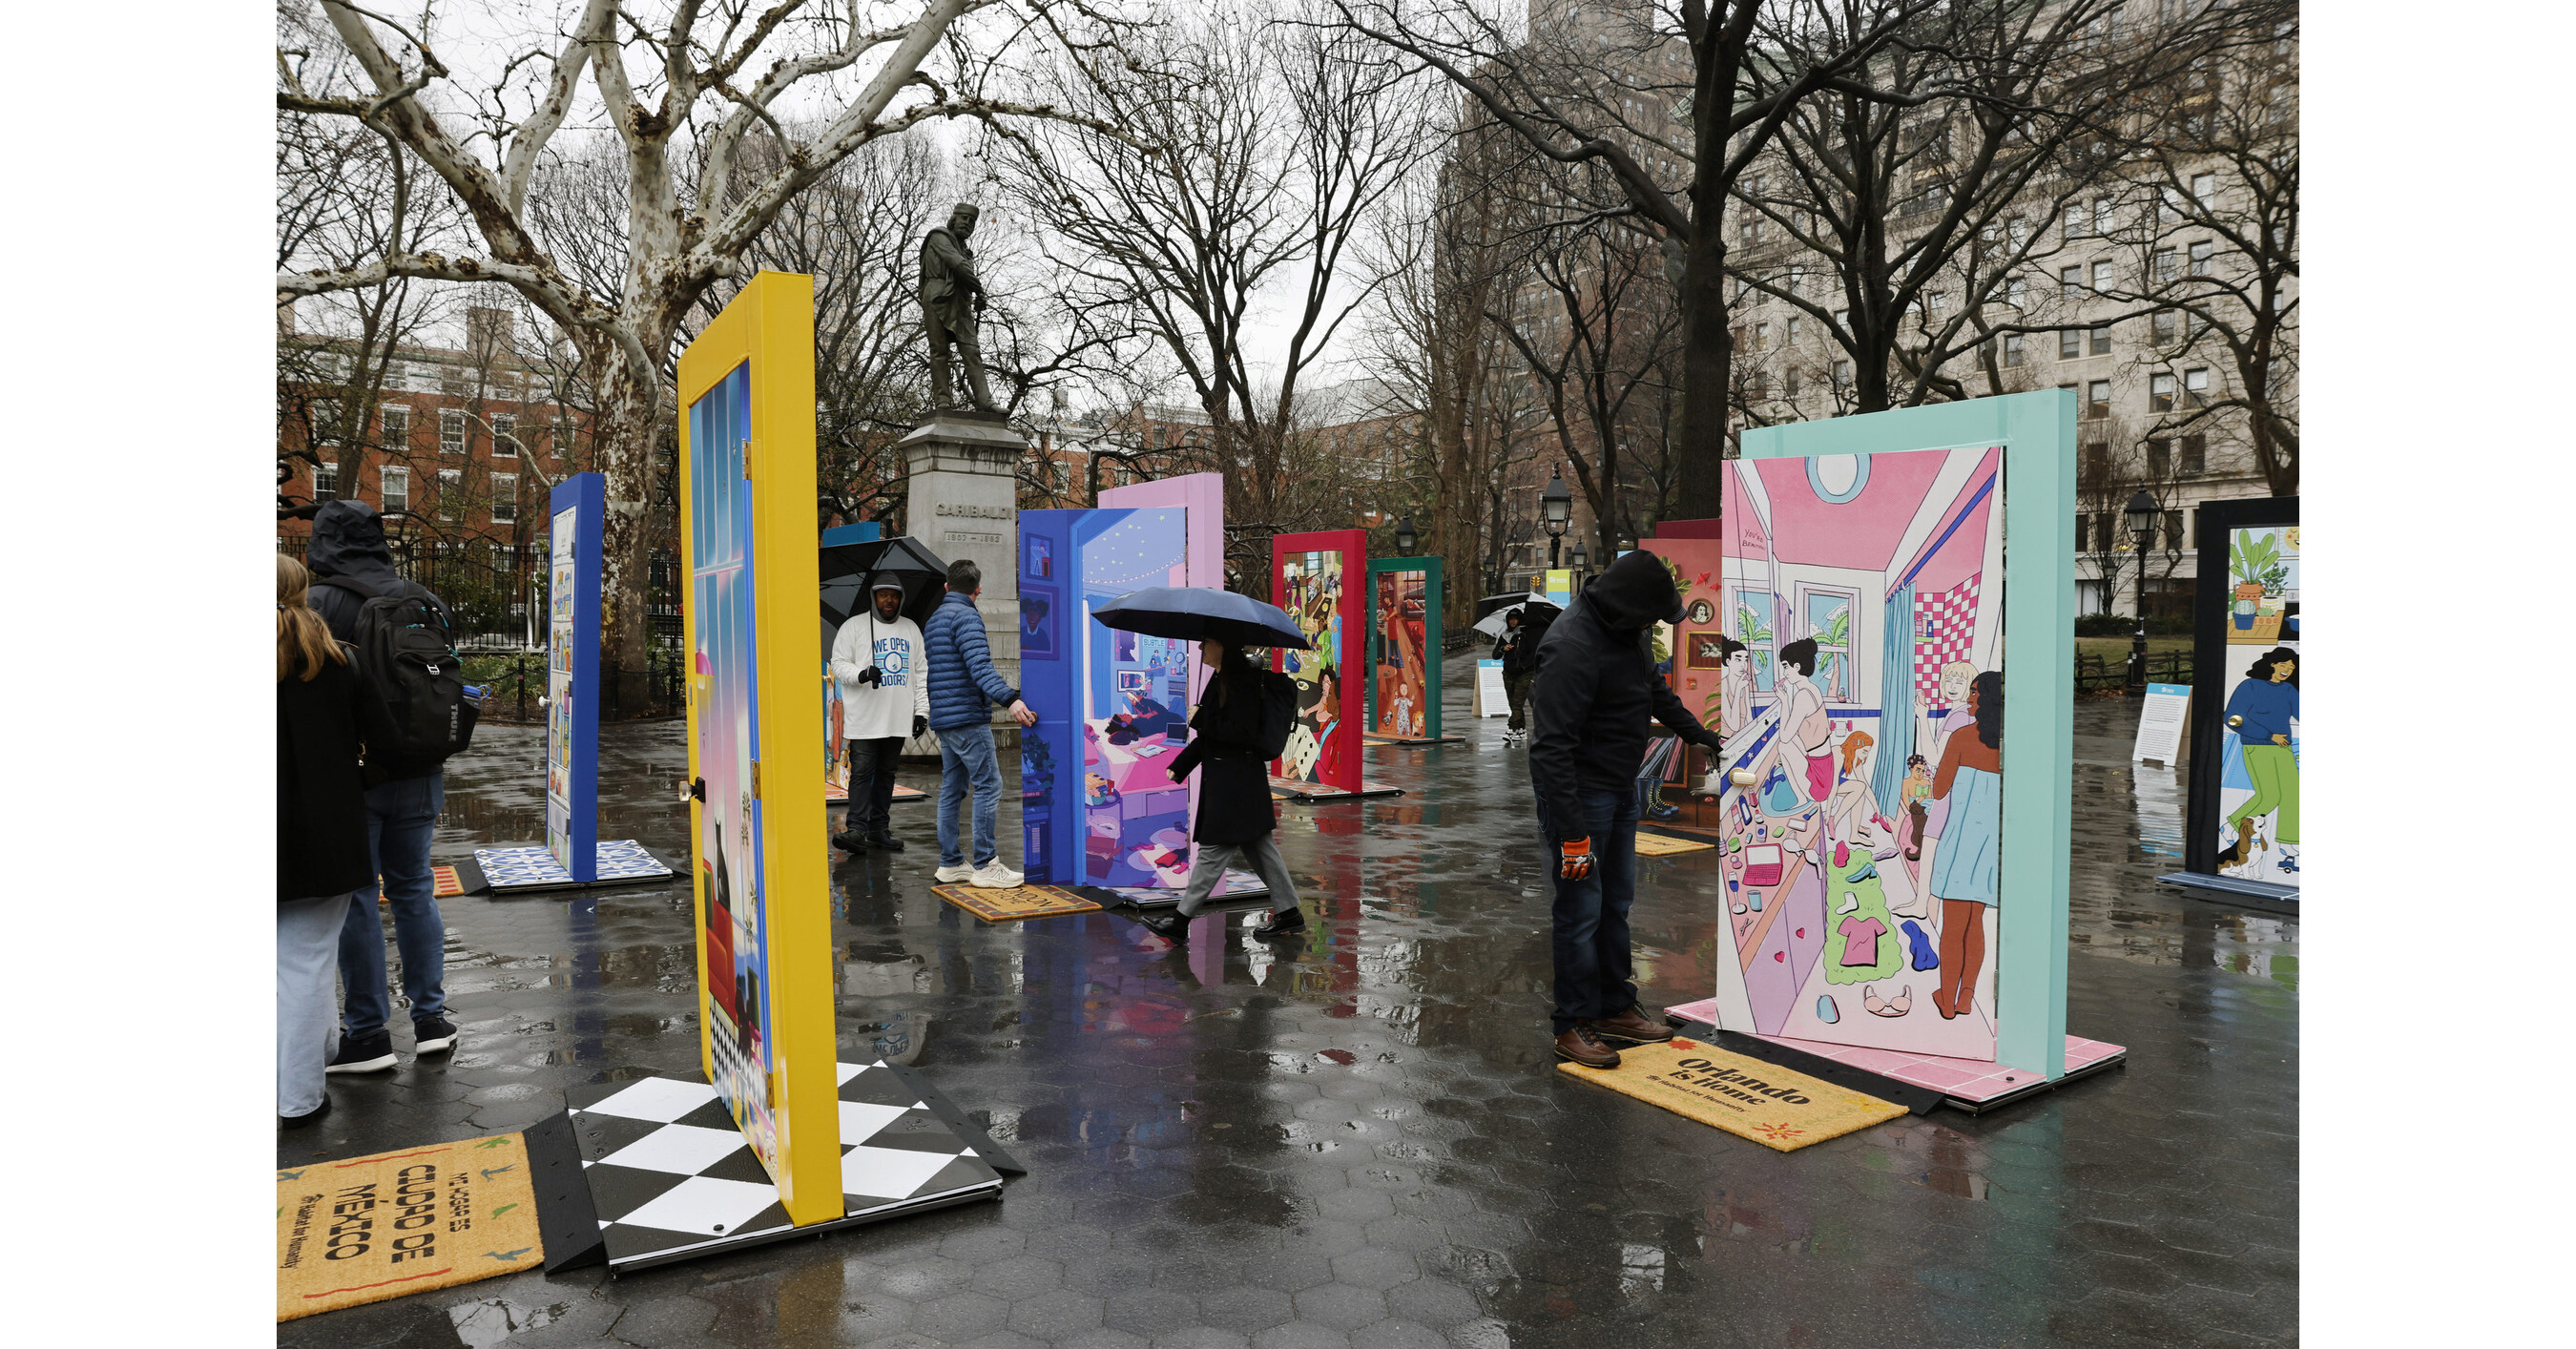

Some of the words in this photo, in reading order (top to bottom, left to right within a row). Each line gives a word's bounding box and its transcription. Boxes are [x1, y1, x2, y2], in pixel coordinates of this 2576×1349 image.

[936, 503, 1012, 520] GARIBALDI
[873, 638, 888, 654] WE
[890, 637, 910, 653] OPEN
[448, 703, 458, 741] THULE
[1003, 887, 1058, 907] ONDON
[1659, 1079, 1691, 1092] Habitat
[1703, 1094, 1746, 1112] Humanity
[1668, 1069, 1695, 1081] is
[1692, 1077, 1766, 1105] Home
[1677, 1058, 1811, 1105] Orlando
[448, 1172, 468, 1187] MI
[393, 1165, 436, 1230] CIUDAD
[448, 1186, 470, 1218] HOGAR
[294, 1203, 317, 1228] Habitat
[324, 1183, 388, 1260] MÉXICO
[449, 1217, 470, 1232] ES
[291, 1226, 311, 1237] for
[279, 1235, 309, 1269] Humanity
[391, 1233, 435, 1263] DE
